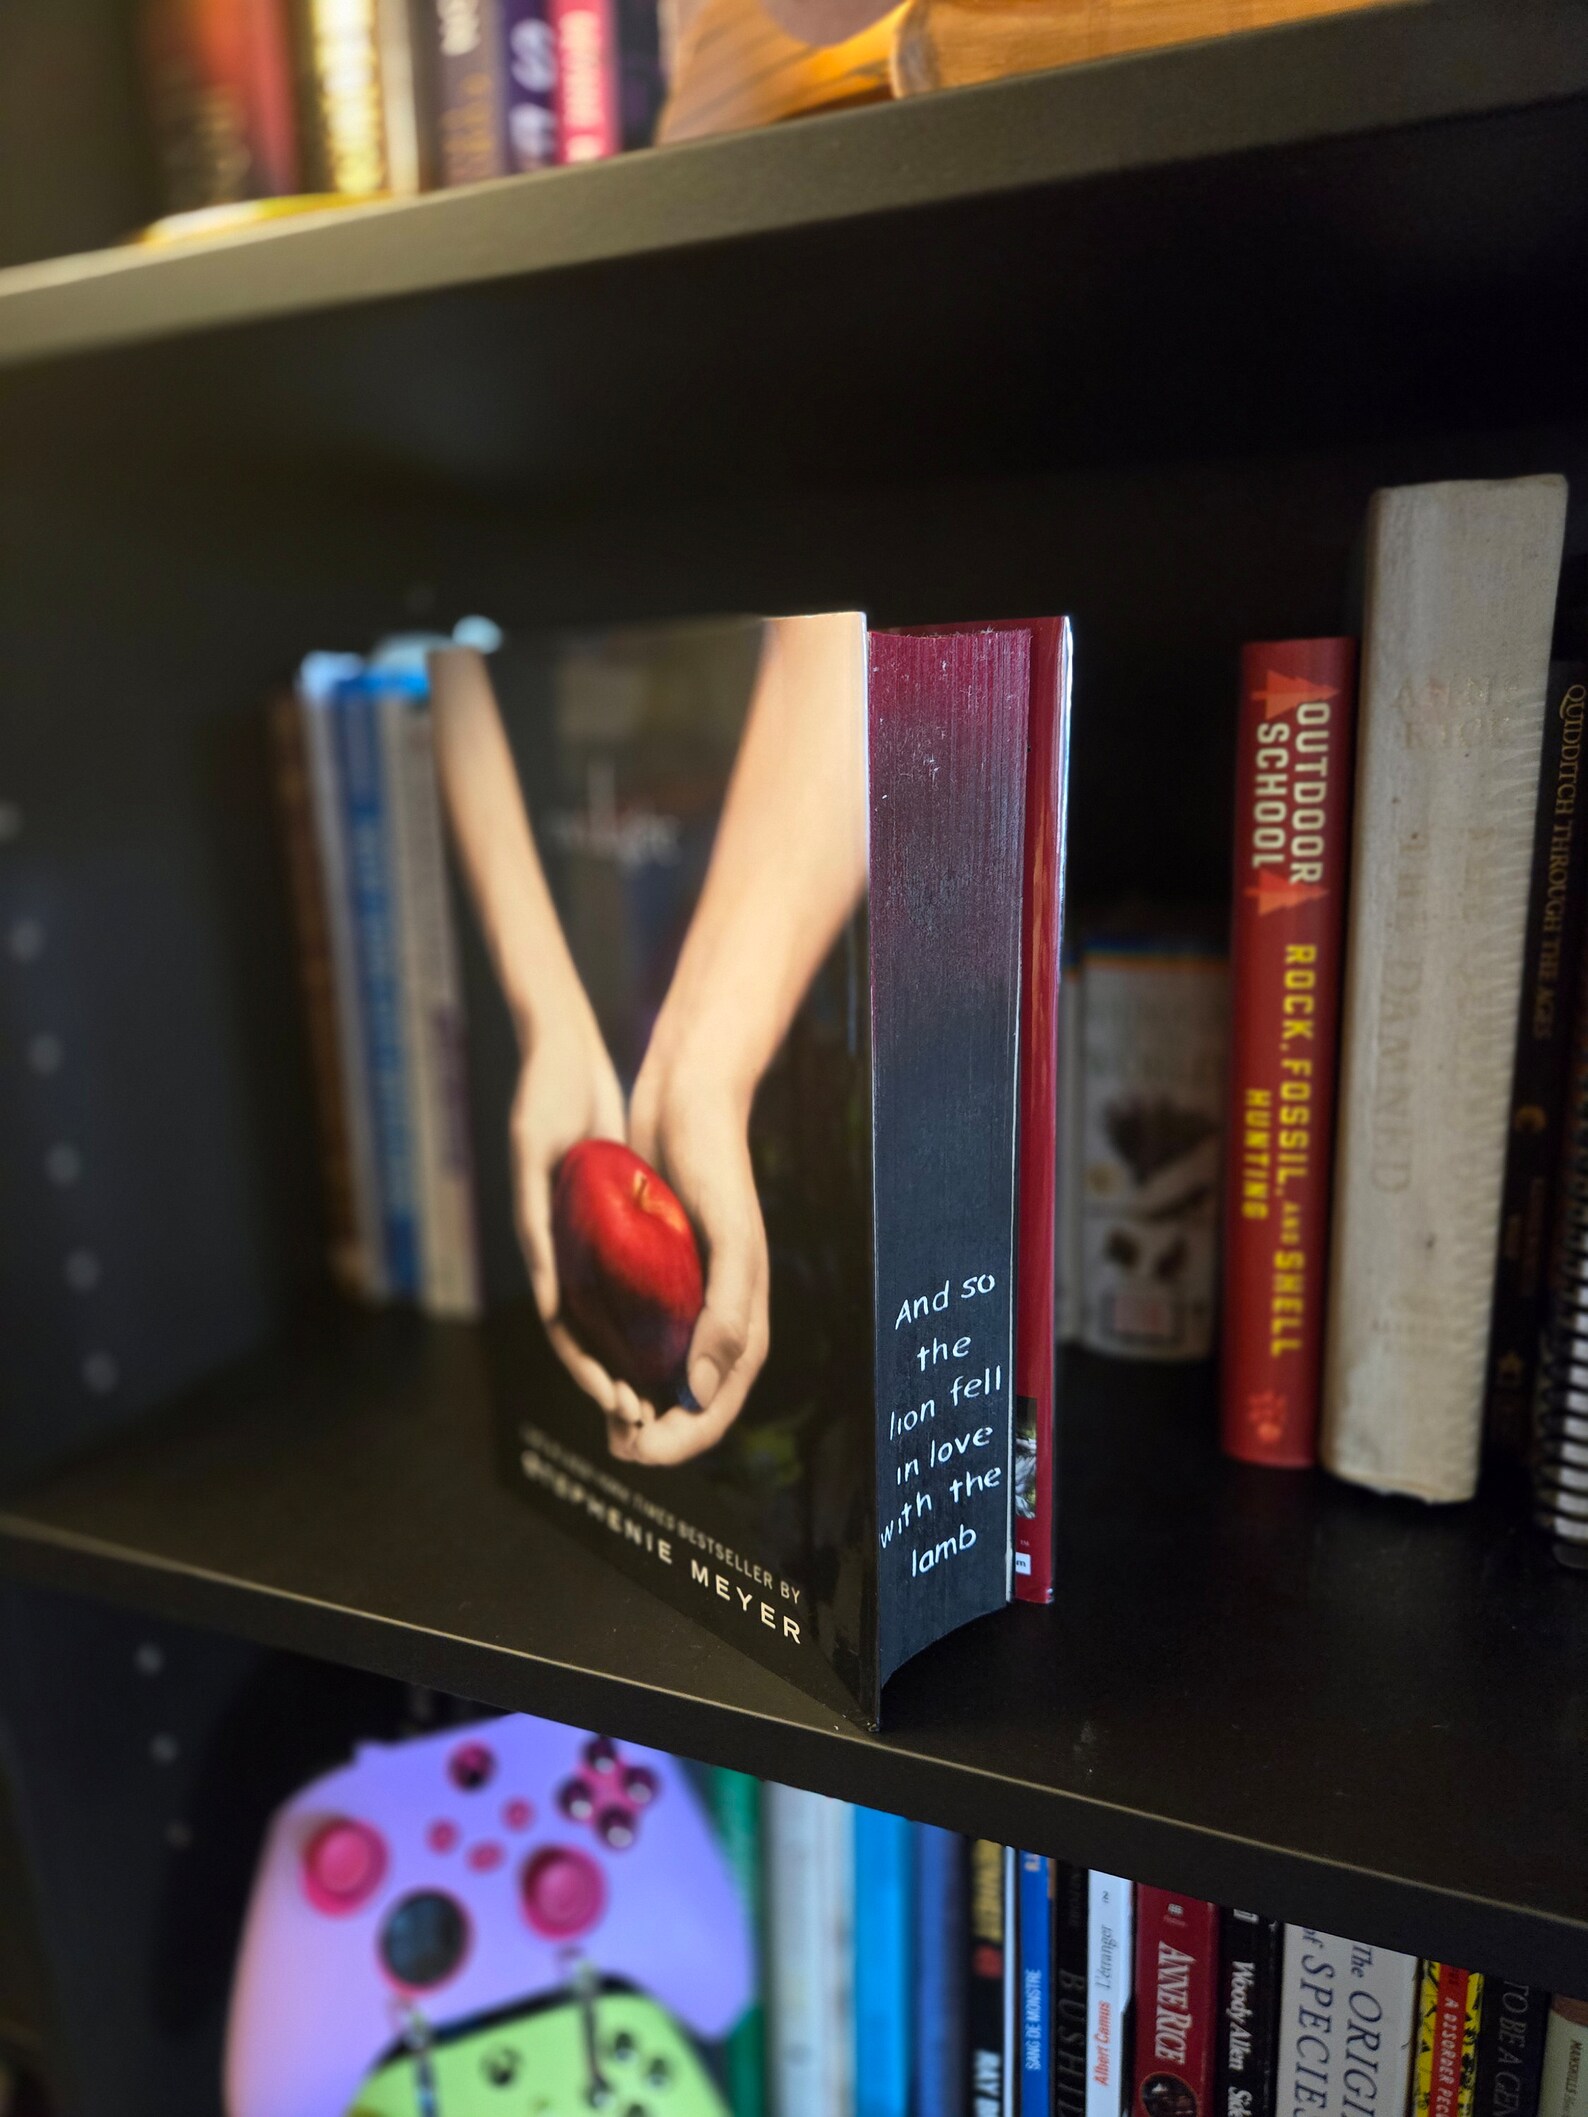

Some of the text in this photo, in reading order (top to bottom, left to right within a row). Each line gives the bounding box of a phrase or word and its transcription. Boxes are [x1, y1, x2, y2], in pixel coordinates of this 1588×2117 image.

[1251, 722, 1290, 870] SCHOOL
[1288, 702, 1331, 884] OUTDOOR
[1532, 684, 1586, 1039] QUIDDITCH THROUGH THE AGES
[1279, 945, 1317, 1052] ROCK,
[1241, 1088, 1272, 1221] HUNTING
[1273, 1059, 1312, 1196] FOSSIL,
[895, 1273, 996, 1330] And so
[1269, 1250, 1305, 1358] SHELL
[917, 1335, 972, 1372] the
[889, 1365, 1001, 1440] lion fell
[896, 1426, 994, 1486] in love
[880, 1466, 1002, 1548] with the
[677, 1521, 774, 1590] BESTSELLER
[780, 1579, 801, 1605] BY
[911, 1523, 977, 1577] lamb
[691, 1559, 802, 1645] MEYER
[1157, 1940, 1197, 2009] ANNE
[1226, 1960, 1256, 2024] Woody
[1444, 1996, 1460, 2009] A
[1024, 1968, 1042, 2071] SANG DE MONSTRE
[1095, 2000, 1111, 2044] Camus
[1154, 2004, 1193, 2065] RICE
[1228, 2021, 1253, 2072] Allen
[1341, 1944, 1384, 2117] The ORIGI
[1438, 2012, 1459, 2085] DISORDER
[1496, 2045, 1523, 2064] A
[1497, 2015, 1529, 2048] BE
[1093, 2047, 1109, 2087] Albert
